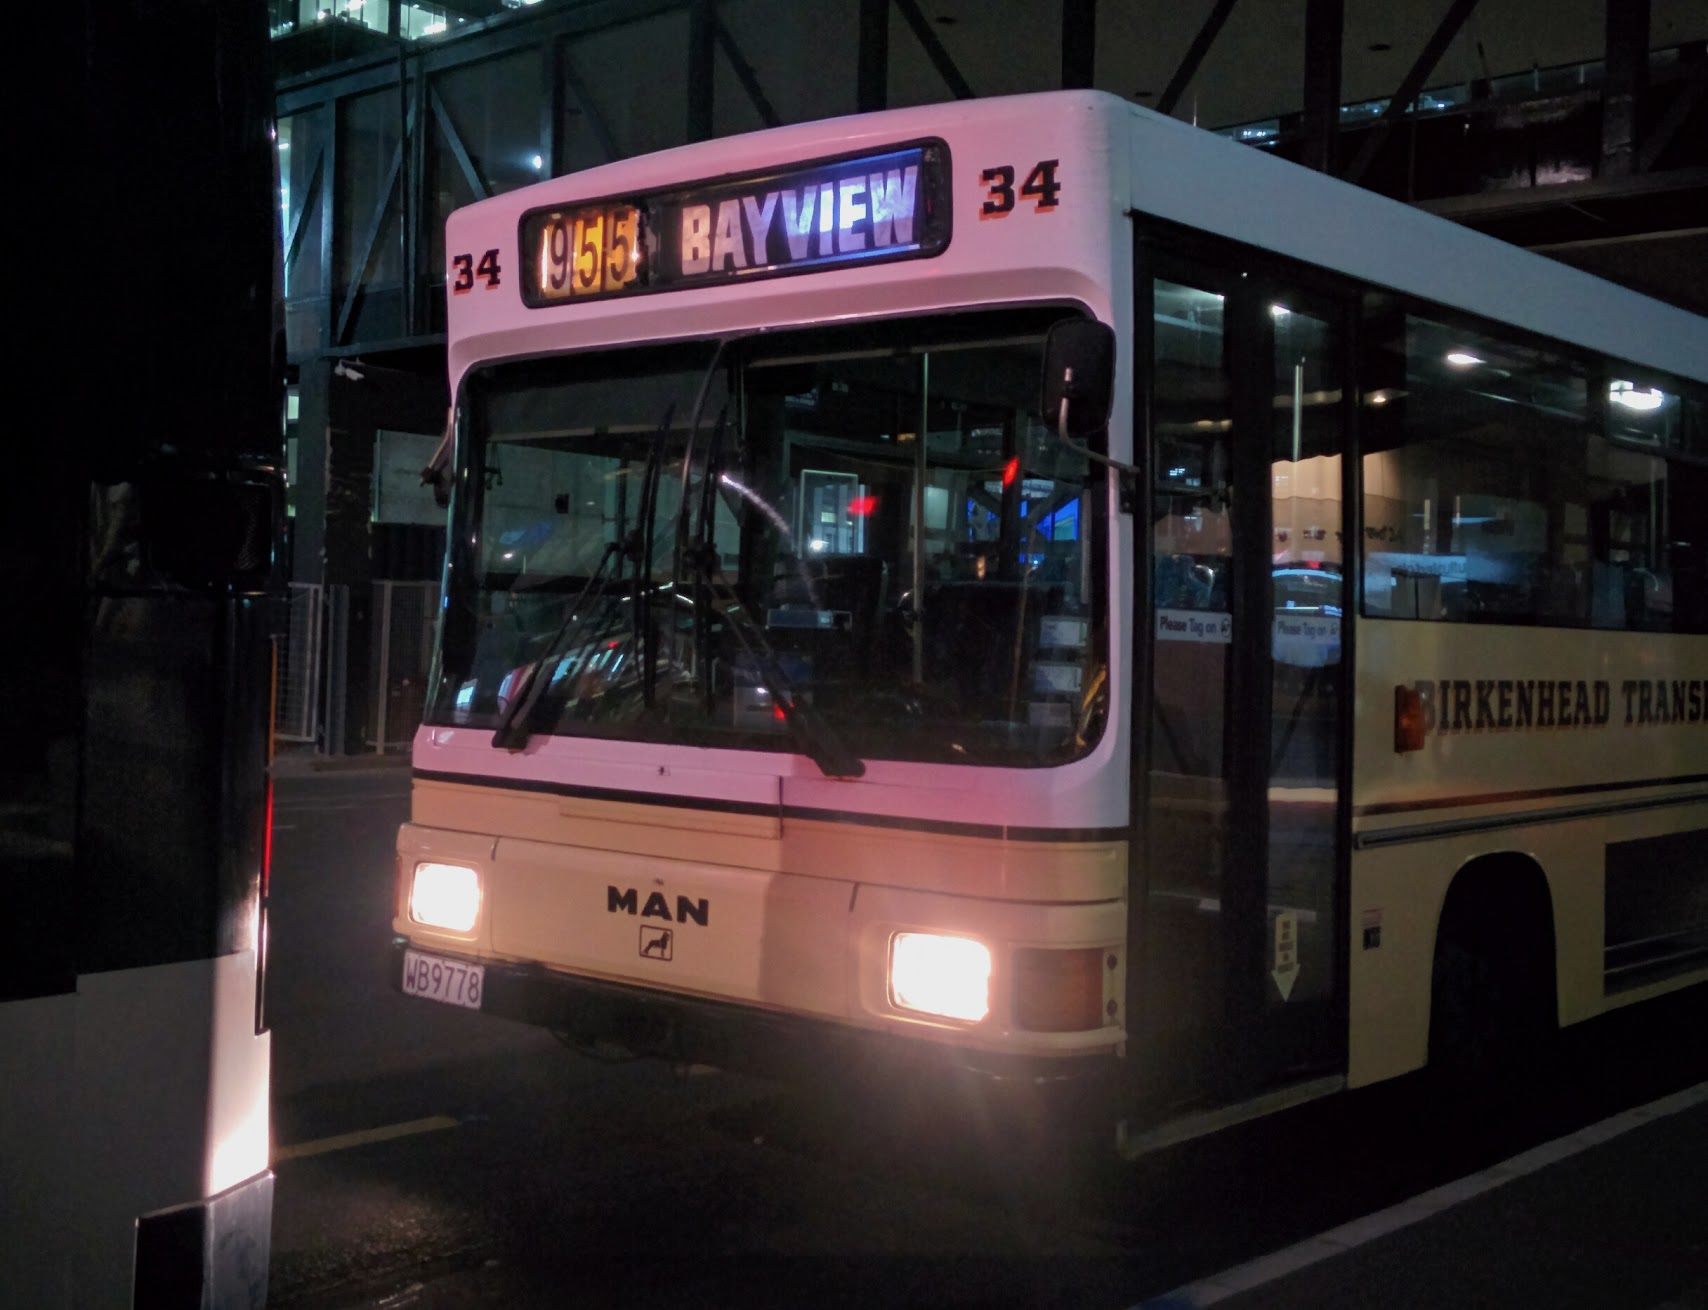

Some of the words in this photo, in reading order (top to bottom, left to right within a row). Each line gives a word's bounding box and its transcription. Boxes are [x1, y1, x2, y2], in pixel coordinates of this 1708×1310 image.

[979, 159, 1061, 220] 34
[550, 211, 631, 290] 955
[680, 165, 918, 276] BAYVIEW
[453, 249, 501, 295] 34
[1160, 616, 1187, 632] Please
[1190, 618, 1204, 637] Tag
[1206, 622, 1217, 634] on
[1278, 621, 1300, 635] Please
[1622, 679, 1708, 725] TRANS
[607, 886, 709, 927] MAN
[404, 952, 481, 1003] WB9778
